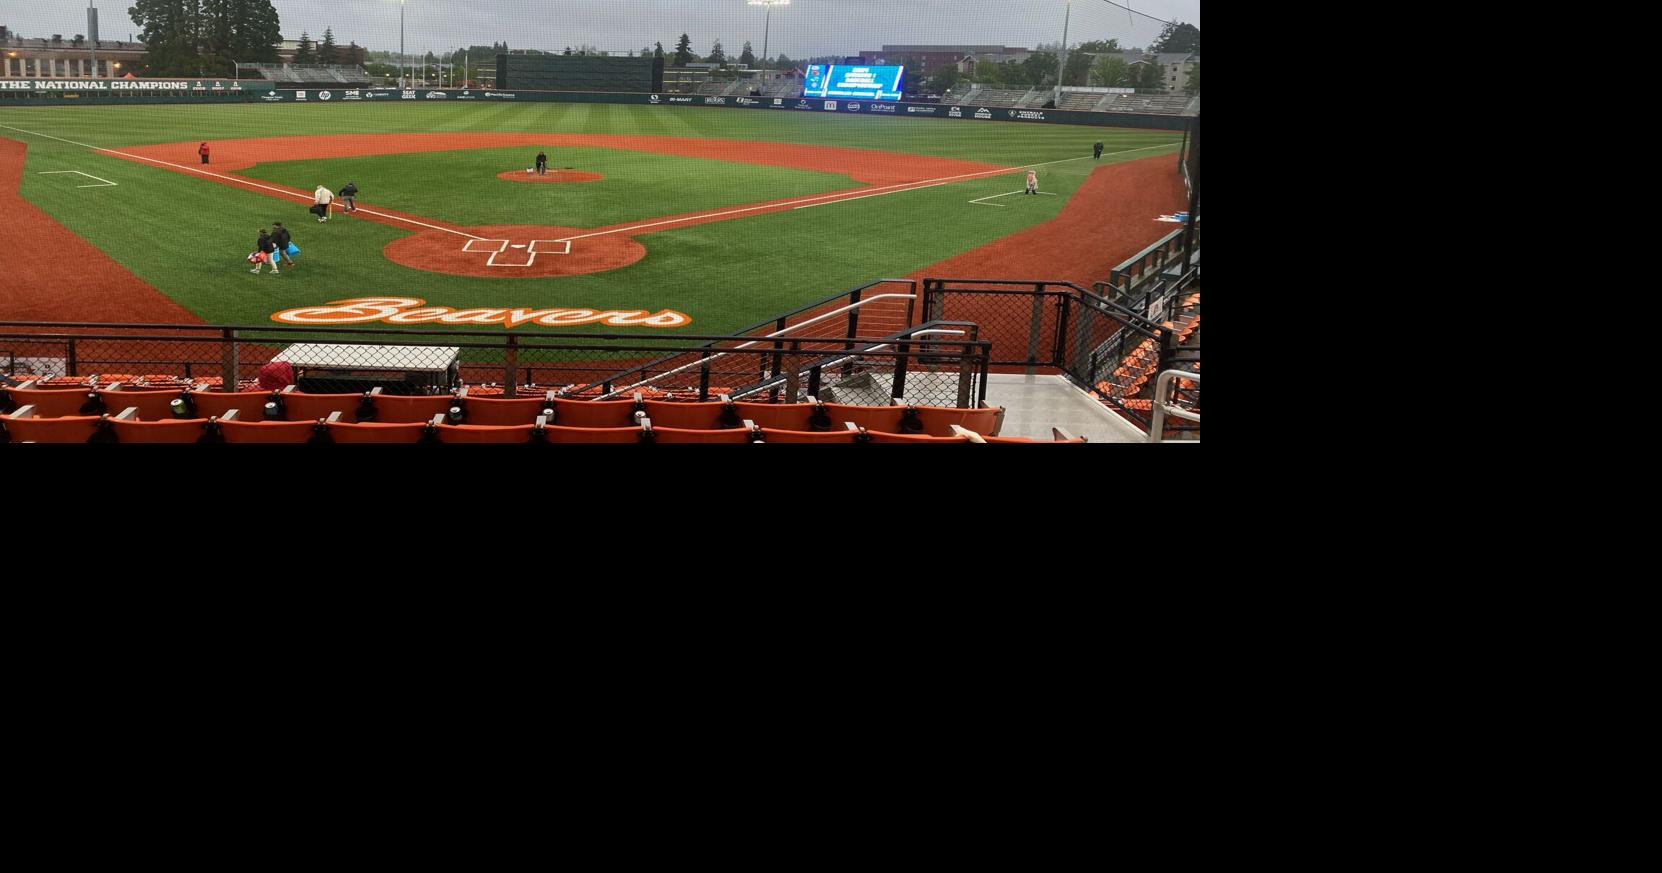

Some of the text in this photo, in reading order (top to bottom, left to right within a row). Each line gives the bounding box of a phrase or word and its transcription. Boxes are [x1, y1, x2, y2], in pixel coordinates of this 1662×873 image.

[0, 80, 188, 91] THE NATIONAL CHAMPIONS
[270, 296, 692, 329] Beavers
